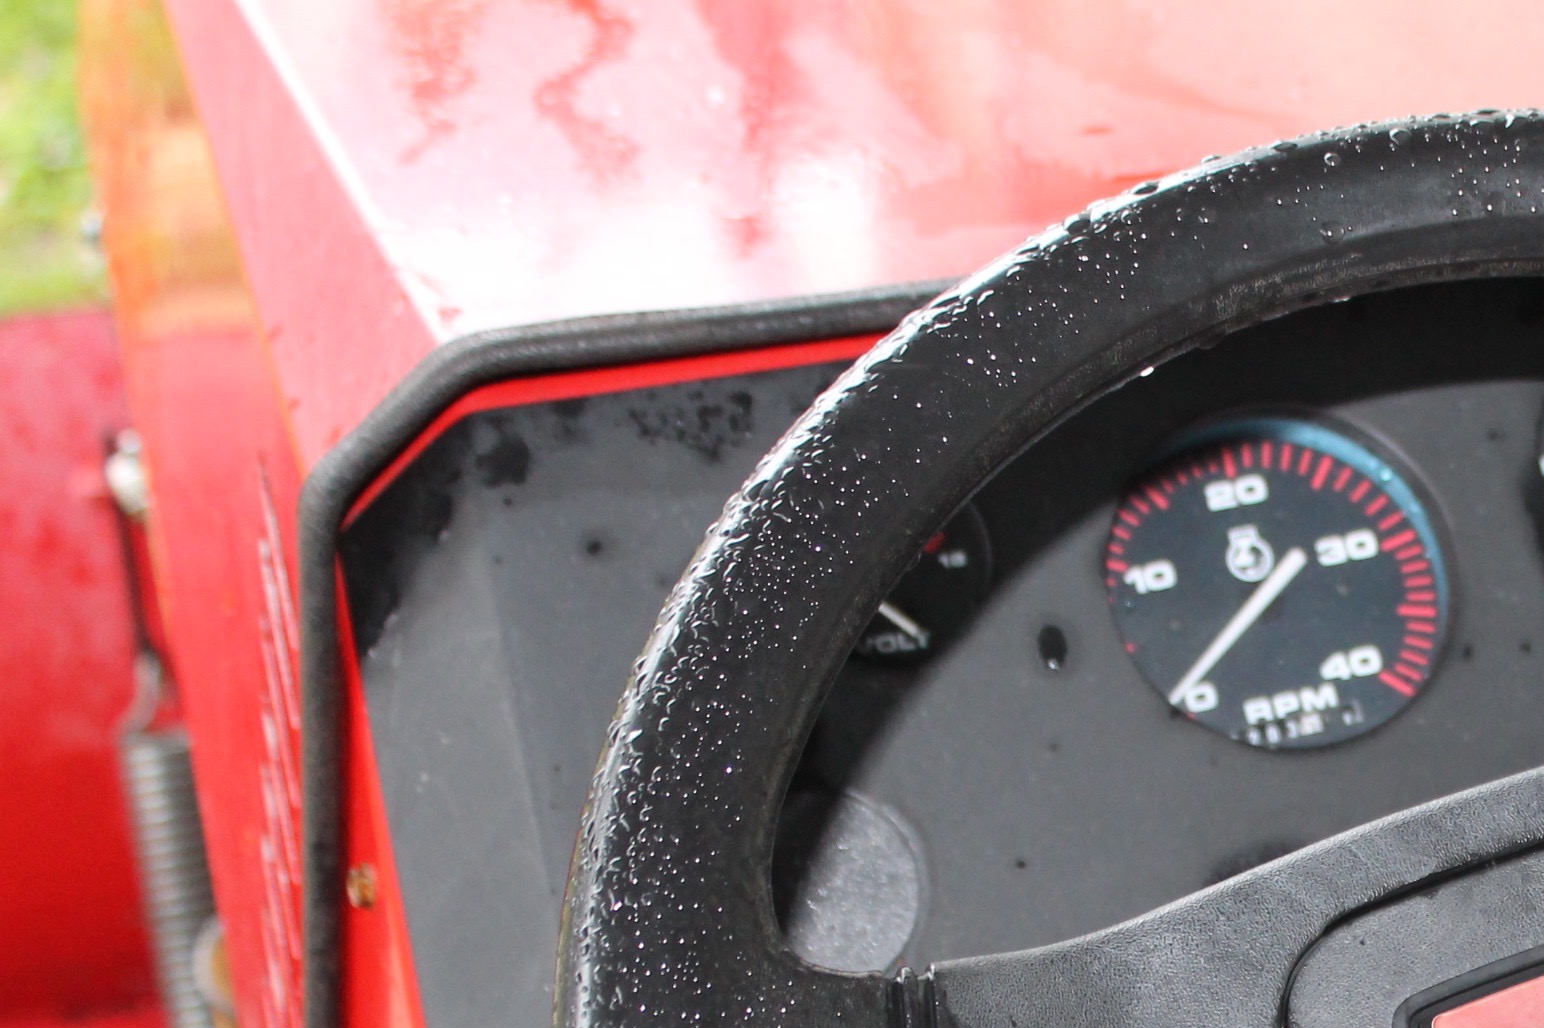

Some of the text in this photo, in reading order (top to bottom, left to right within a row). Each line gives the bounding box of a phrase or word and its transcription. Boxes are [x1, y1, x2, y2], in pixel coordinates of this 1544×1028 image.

[1204, 474, 1268, 511] 20
[1315, 530, 1378, 566] 30
[1126, 560, 1177, 593] 10
[1320, 645, 1384, 682] 40
[1184, 683, 1219, 712] 0
[1242, 682, 1339, 725] RPM
